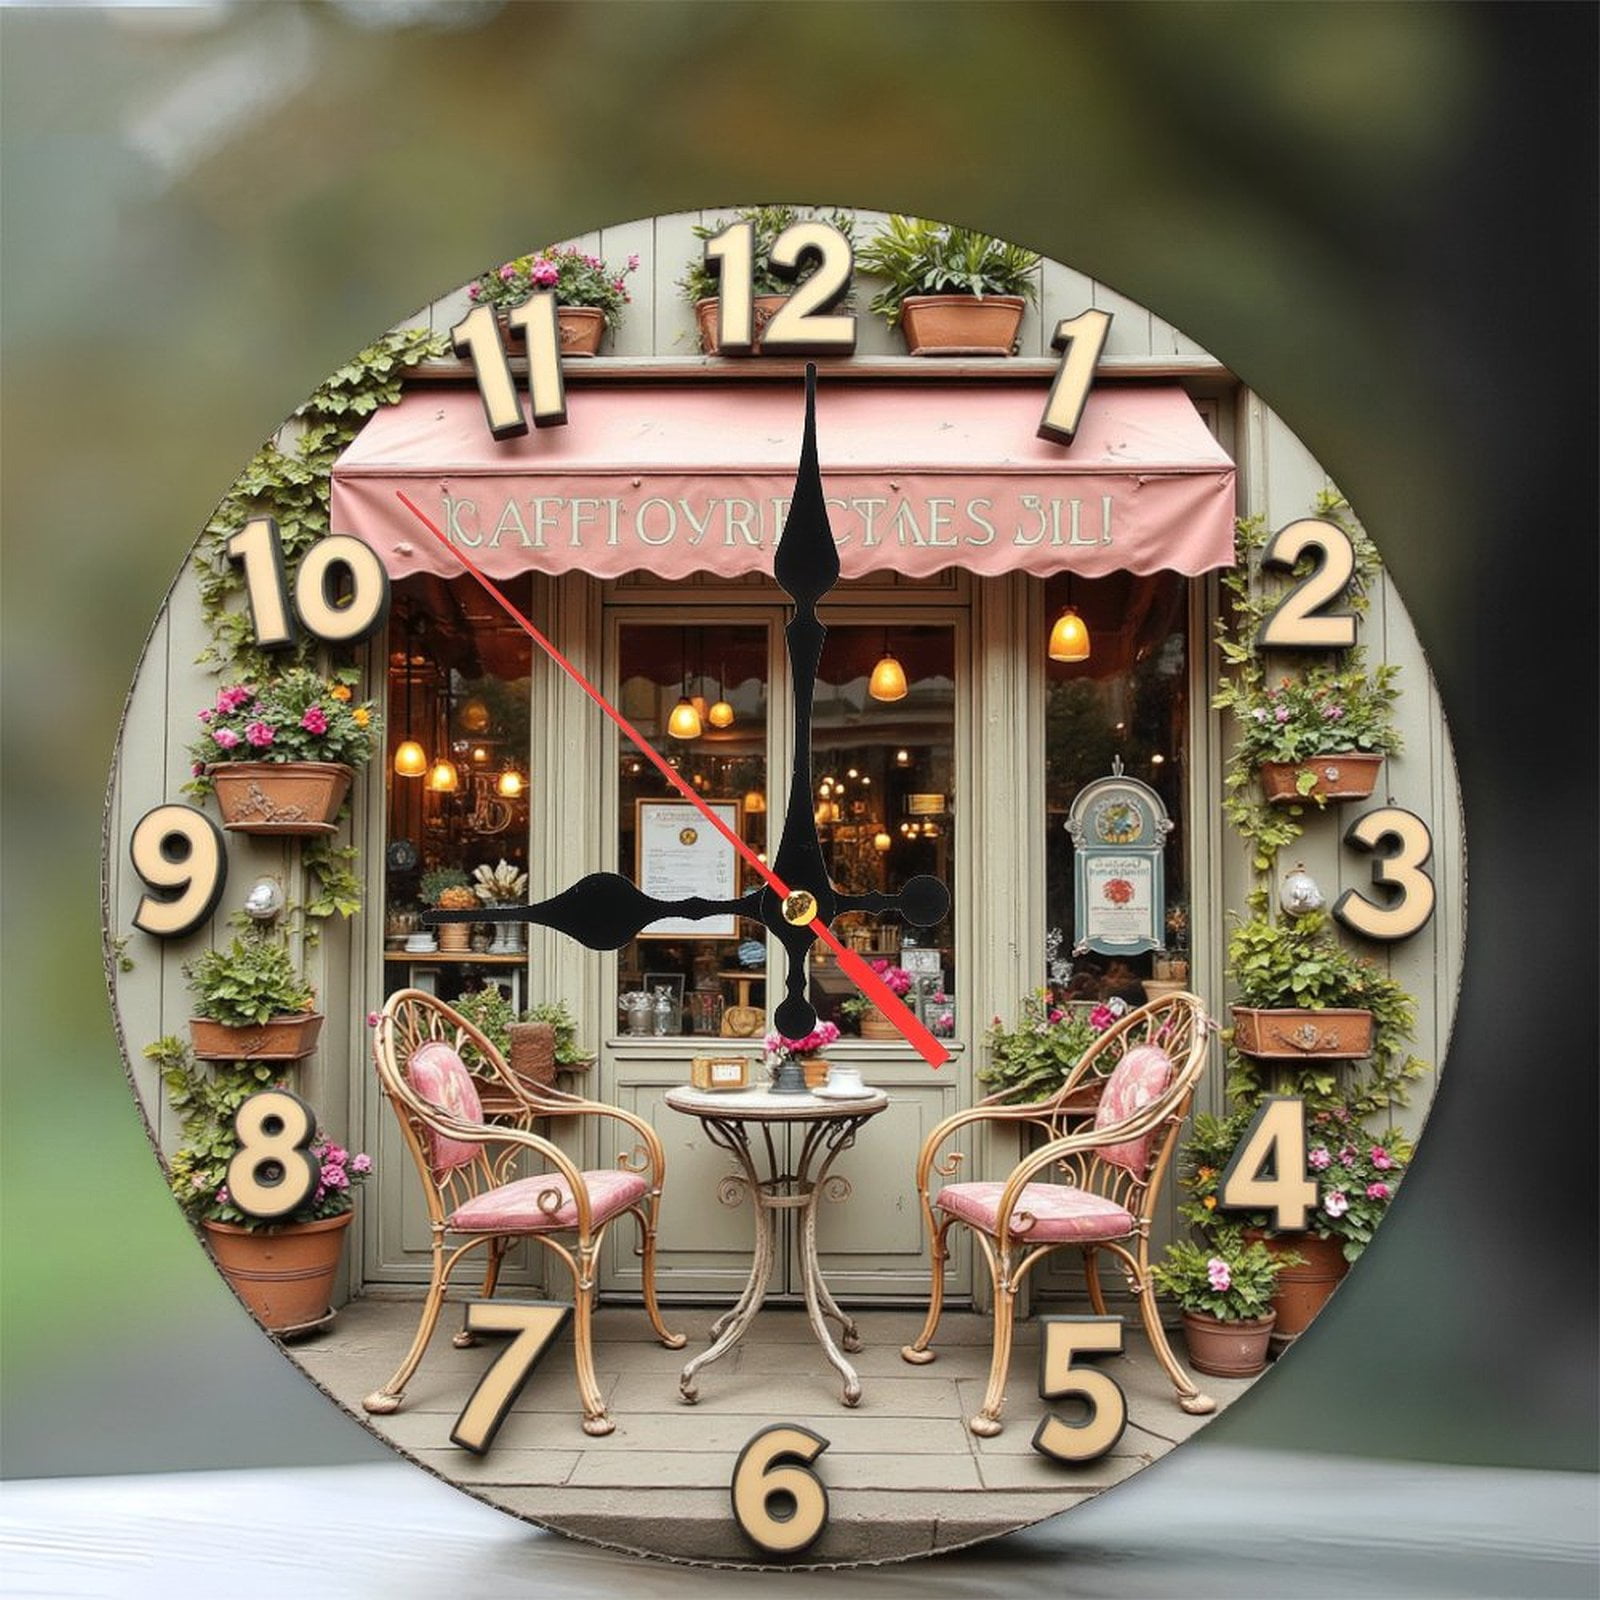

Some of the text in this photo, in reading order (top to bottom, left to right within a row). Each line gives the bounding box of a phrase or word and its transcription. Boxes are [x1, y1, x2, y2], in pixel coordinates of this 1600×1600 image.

[704, 219, 857, 356] 12
[450, 288, 568, 441] 11
[1036, 308, 1114, 446] 1
[226, 514, 390, 647] 10
[1256, 517, 1358, 650] 2
[130, 804, 228, 938] 9
[1332, 806, 1436, 941] 3
[226, 1089, 322, 1220] 8
[1219, 1096, 1320, 1234] 4
[449, 1300, 574, 1456] 7
[1031, 1314, 1128, 1464] 5
[731, 1421, 830, 1554] 6
